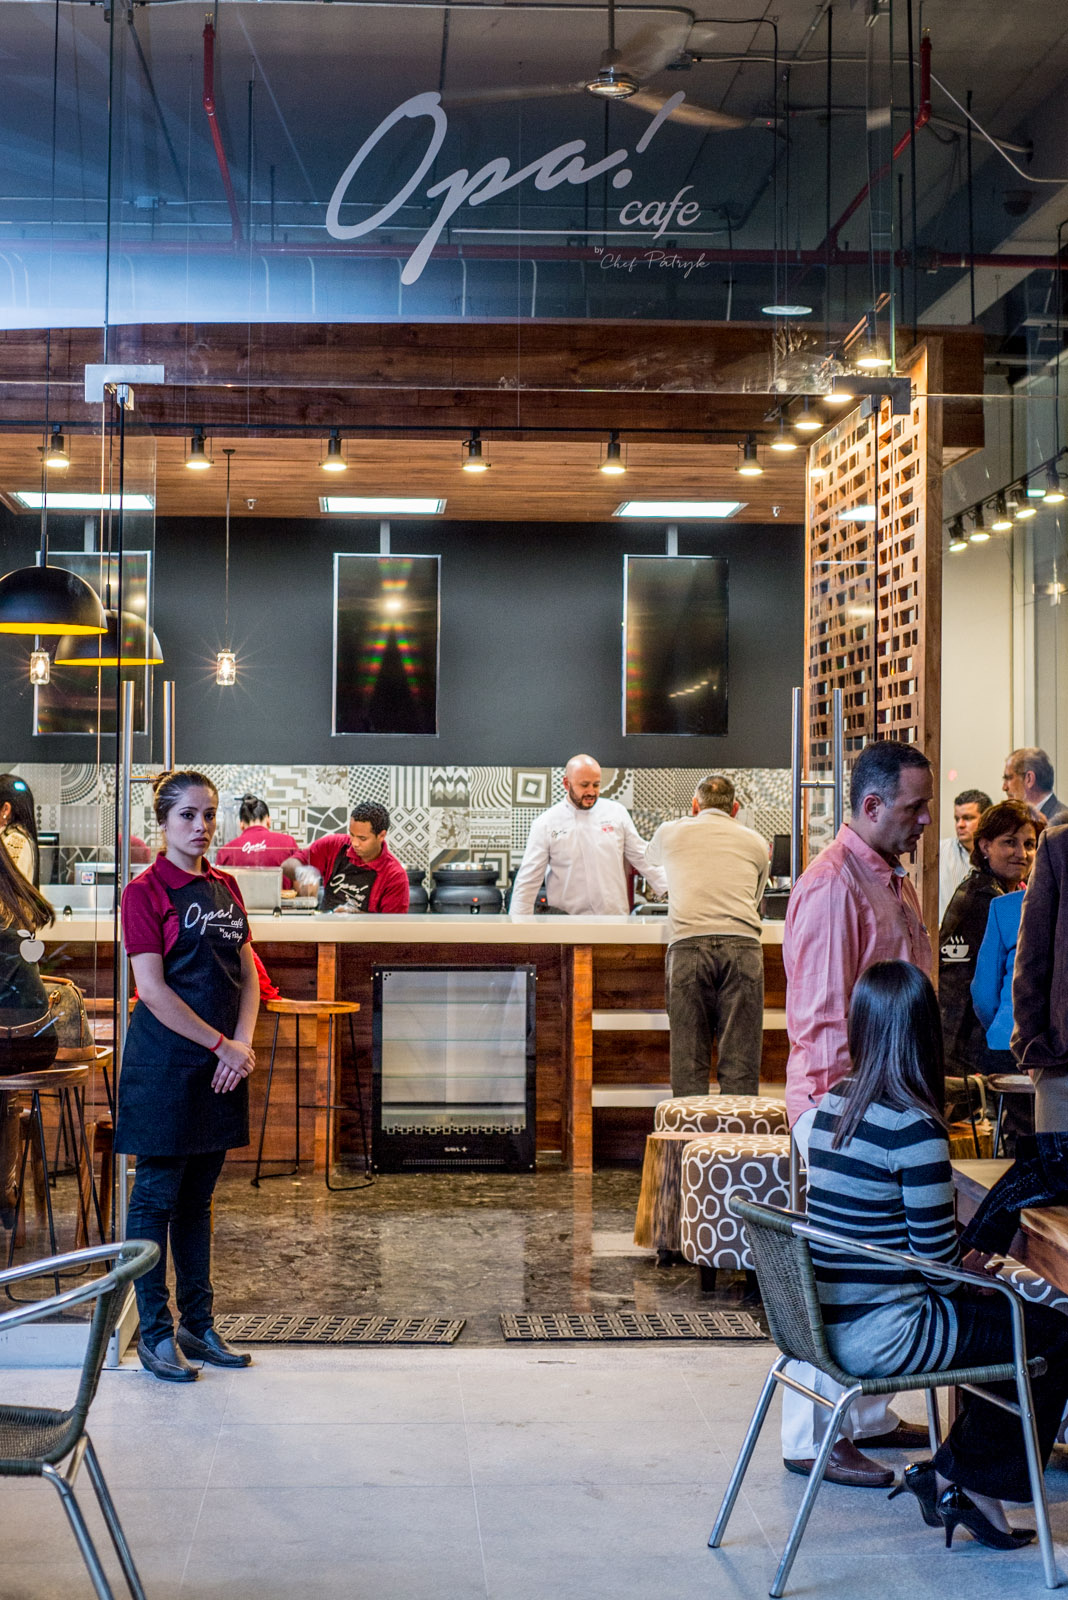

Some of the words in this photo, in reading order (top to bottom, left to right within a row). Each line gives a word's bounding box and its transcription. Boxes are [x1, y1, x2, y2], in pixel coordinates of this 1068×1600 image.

[325, 91, 686, 285] Opa!
[619, 185, 701, 240] cafe
[594, 246, 604, 255] by
[600, 253, 637, 272] Chef
[644, 250, 710, 279] Patryk
[184, 902, 234, 935] Opa!
